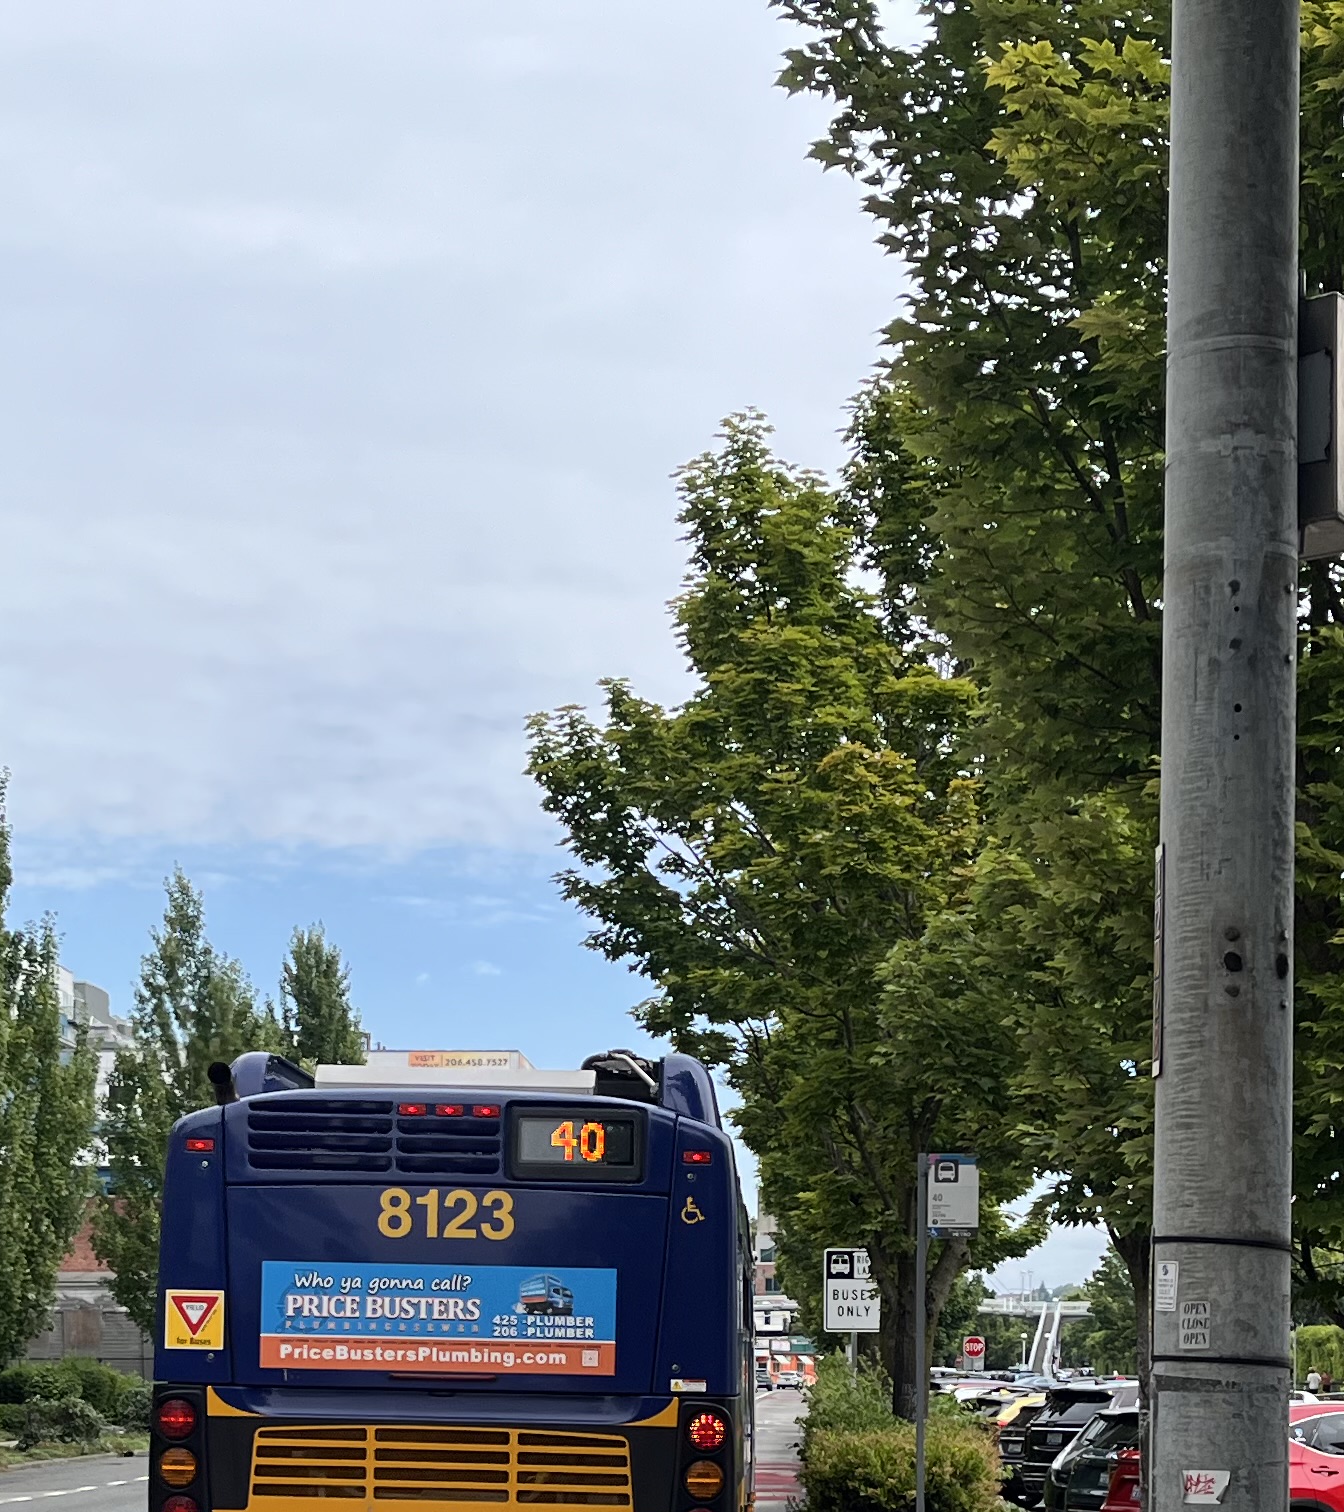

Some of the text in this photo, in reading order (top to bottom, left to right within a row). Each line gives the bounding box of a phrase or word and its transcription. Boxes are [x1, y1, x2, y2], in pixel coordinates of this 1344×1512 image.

[551, 1121, 605, 1161] 40
[932, 1193, 943, 1202] 40
[378, 1188, 515, 1240] 8123
[857, 1256, 870, 1264] RIG
[294, 1272, 472, 1295] Who ya gonna call?
[286, 1295, 481, 1321] PRICE BUSTERS
[837, 1306, 871, 1317] ONLY
[1184, 1303, 1207, 1314] OPEN
[492, 1315, 594, 1327] 425 -PLUMBER
[1182, 1318, 1209, 1330] CLOSE
[493, 1326, 594, 1339] 206 -PLUMBER
[1183, 1332, 1206, 1345] OPEN
[965, 1343, 983, 1352] STOP
[279, 1344, 567, 1367] PriceBustersPlumbing.com
